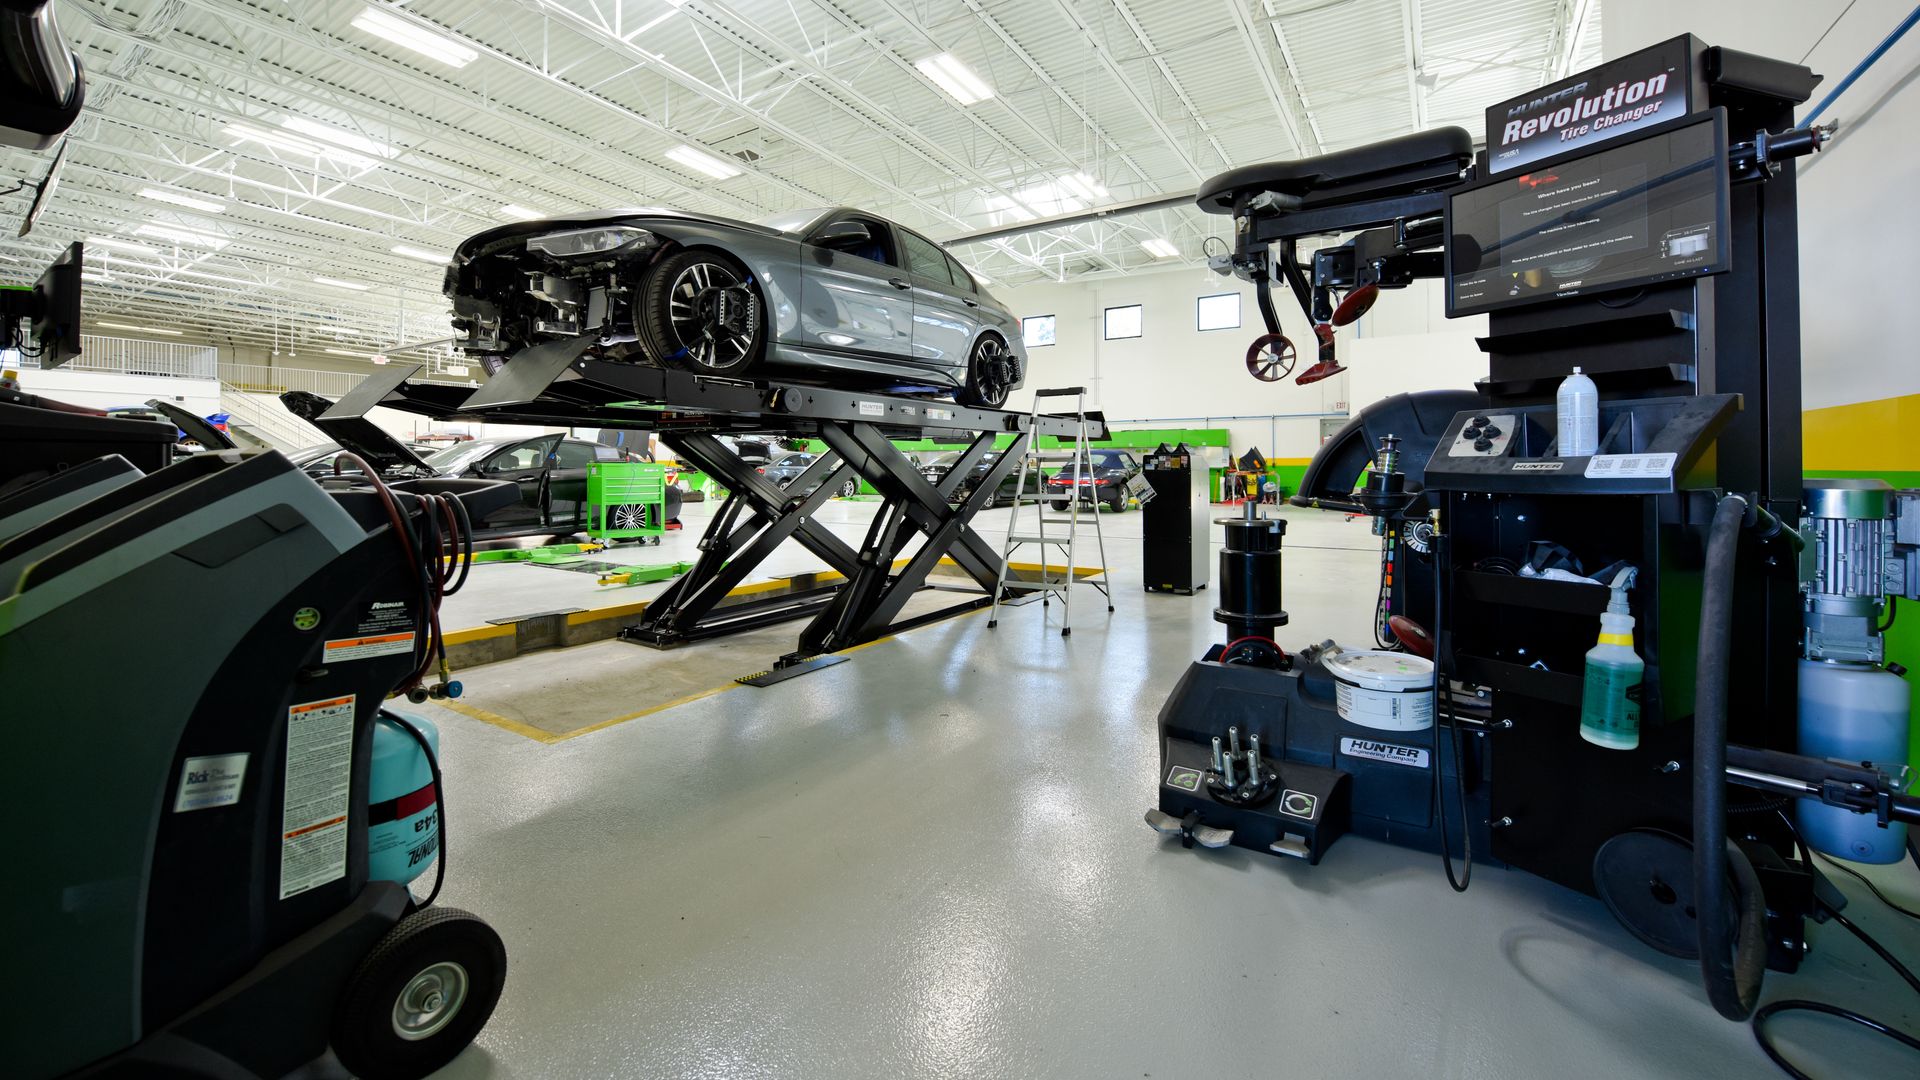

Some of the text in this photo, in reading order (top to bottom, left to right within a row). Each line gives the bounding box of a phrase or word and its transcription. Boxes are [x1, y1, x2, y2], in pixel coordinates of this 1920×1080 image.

[1501, 73, 1668, 146] Revolution
[1507, 82, 1588, 119] HUNTER
[1560, 100, 1663, 142] Tire Changer
[1583, 179, 1600, 187] been?
[1350, 748, 1418, 764] Engineering Company
[1351, 740, 1420, 758] HUNTER
